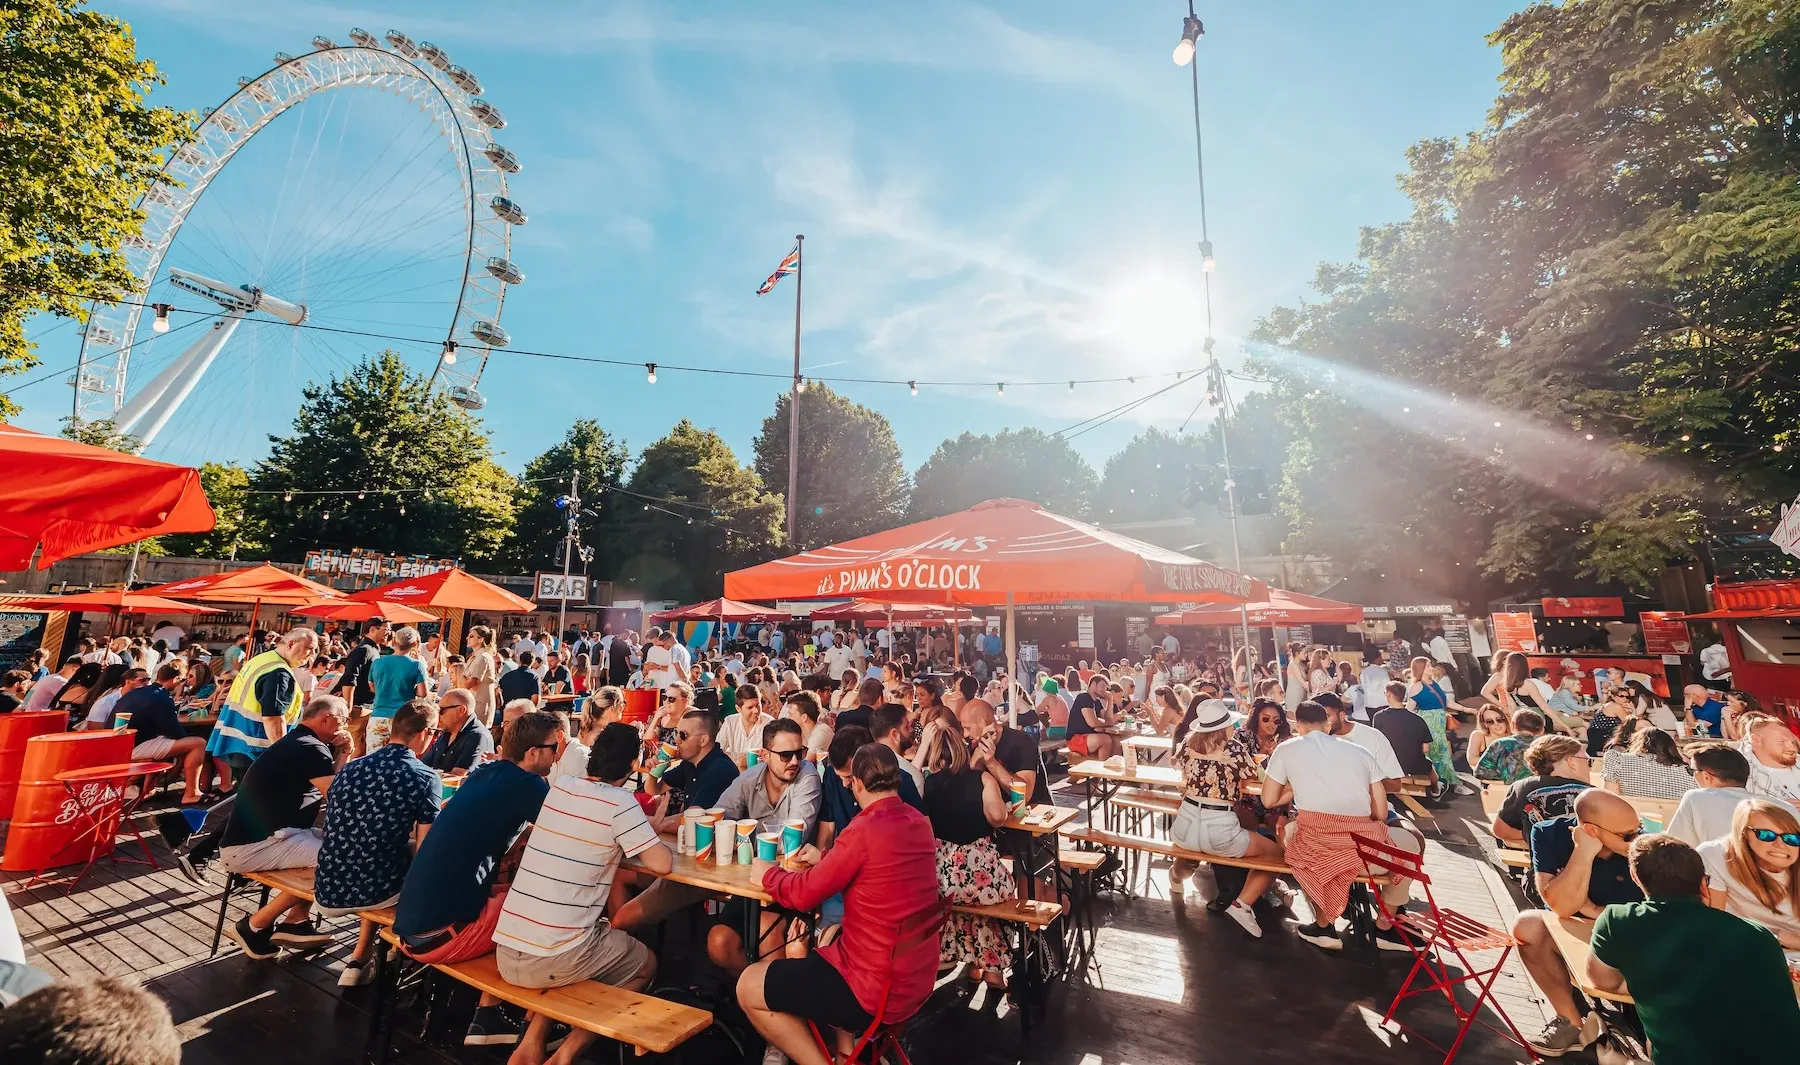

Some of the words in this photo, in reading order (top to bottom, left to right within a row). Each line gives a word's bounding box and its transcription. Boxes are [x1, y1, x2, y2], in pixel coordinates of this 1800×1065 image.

[311, 555, 381, 576] BETWEEN
[838, 561, 893, 593] PIMM'S
[897, 558, 981, 590] O'CLOCK
[540, 577, 586, 597] BAR
[1396, 605, 1420, 614] DUCK
[1421, 604, 1453, 614] WRAPS
[79, 783, 99, 799] El
